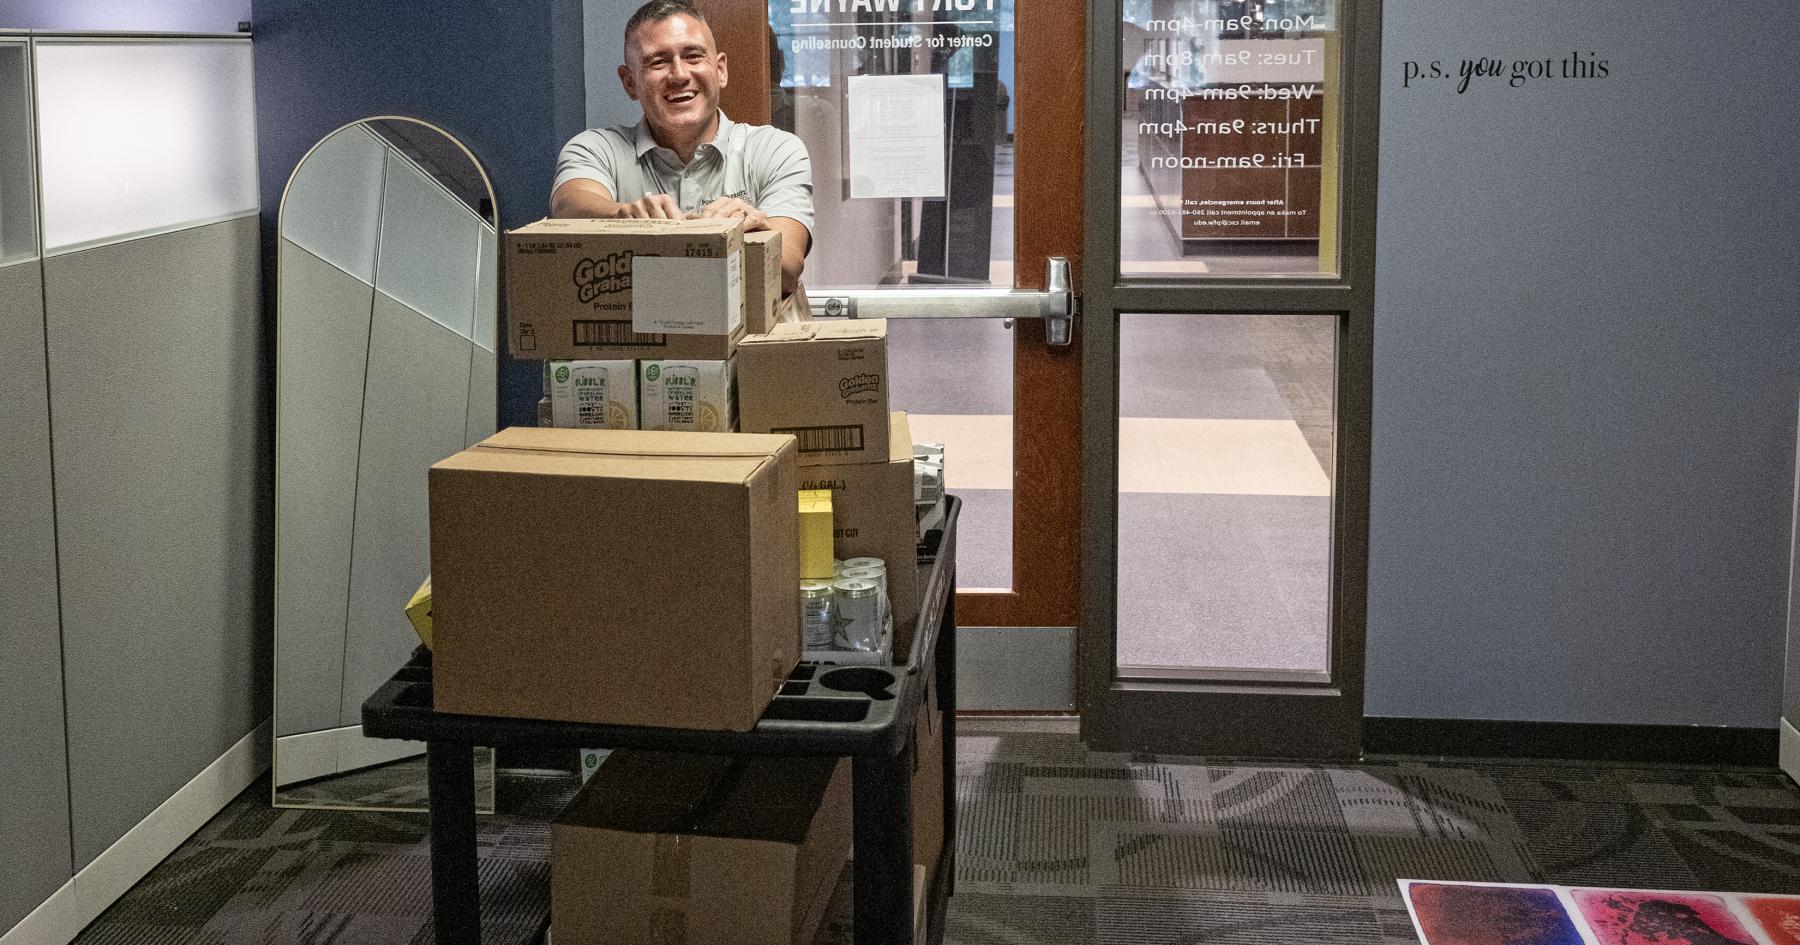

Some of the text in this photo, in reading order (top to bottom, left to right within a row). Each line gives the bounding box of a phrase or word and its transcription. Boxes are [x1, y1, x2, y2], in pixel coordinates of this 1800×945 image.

[1402, 51, 1609, 94] p.s. you got this
[685, 248, 713, 257] 17415
[572, 249, 634, 288] Gold
[577, 275, 633, 304] Graha
[593, 302, 626, 311] Protein
[838, 373, 880, 390] Golden
[820, 480, 846, 491] GAL.)
[845, 528, 859, 538] CUT
